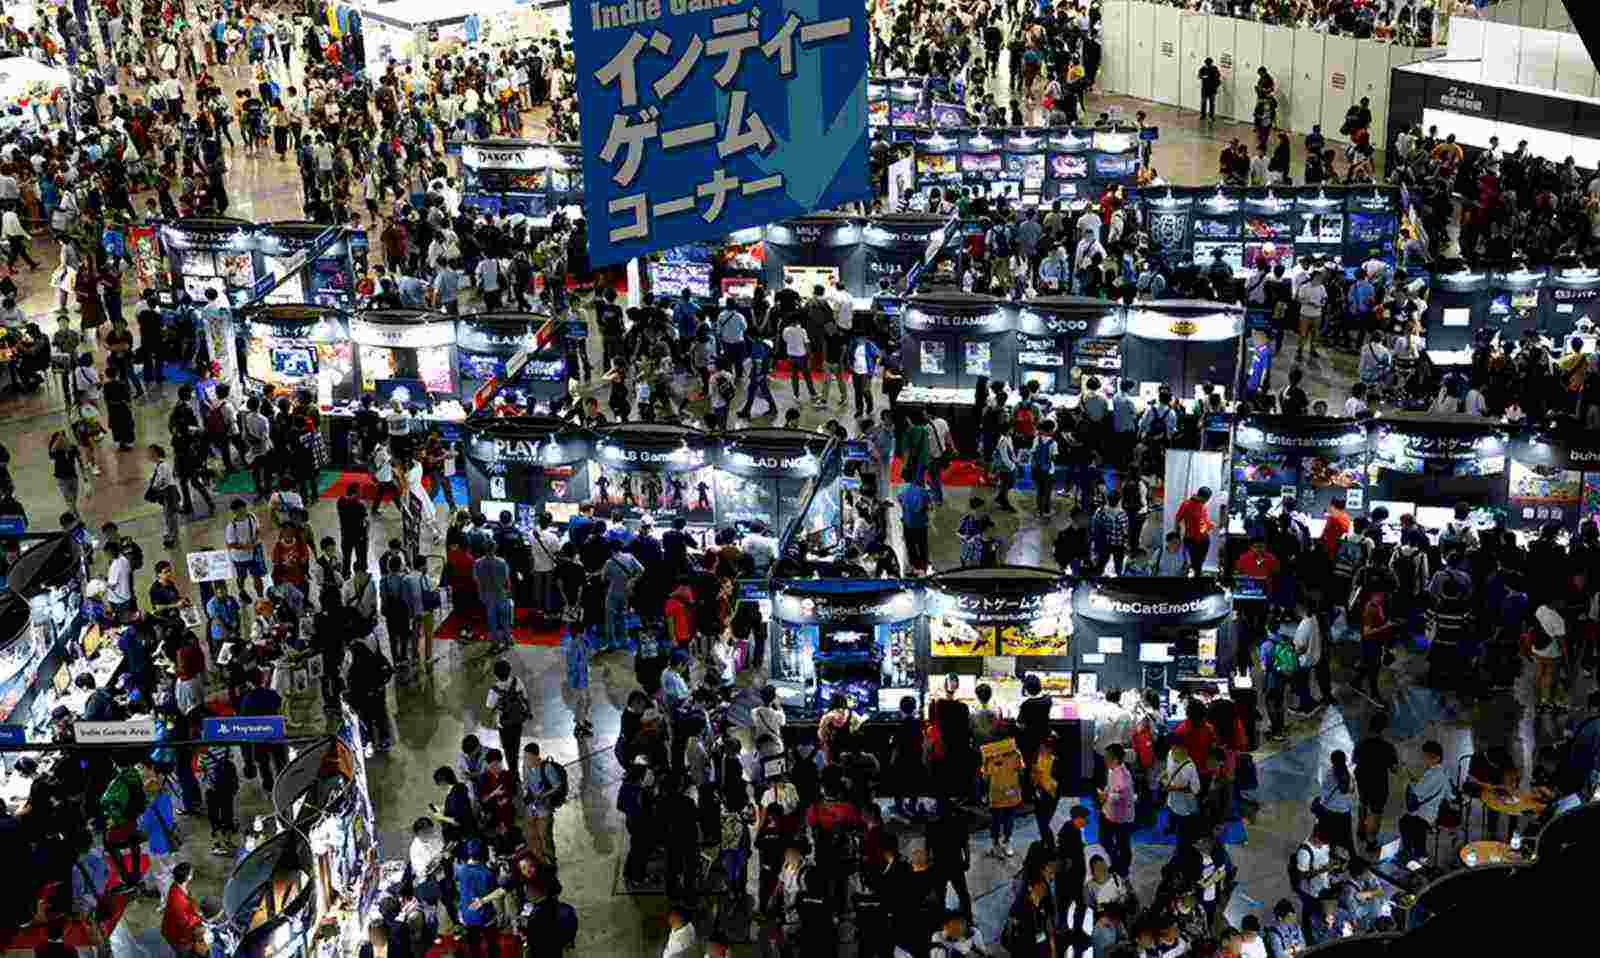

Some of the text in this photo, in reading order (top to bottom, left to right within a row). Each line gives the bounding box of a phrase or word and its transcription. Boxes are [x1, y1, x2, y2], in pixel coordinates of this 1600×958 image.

[591, 0, 662, 29] Indie
[593, 7, 852, 107] インディー
[600, 91, 776, 186] ゲーム
[607, 168, 784, 243] コーナー
[494, 439, 542, 456] PLAY
